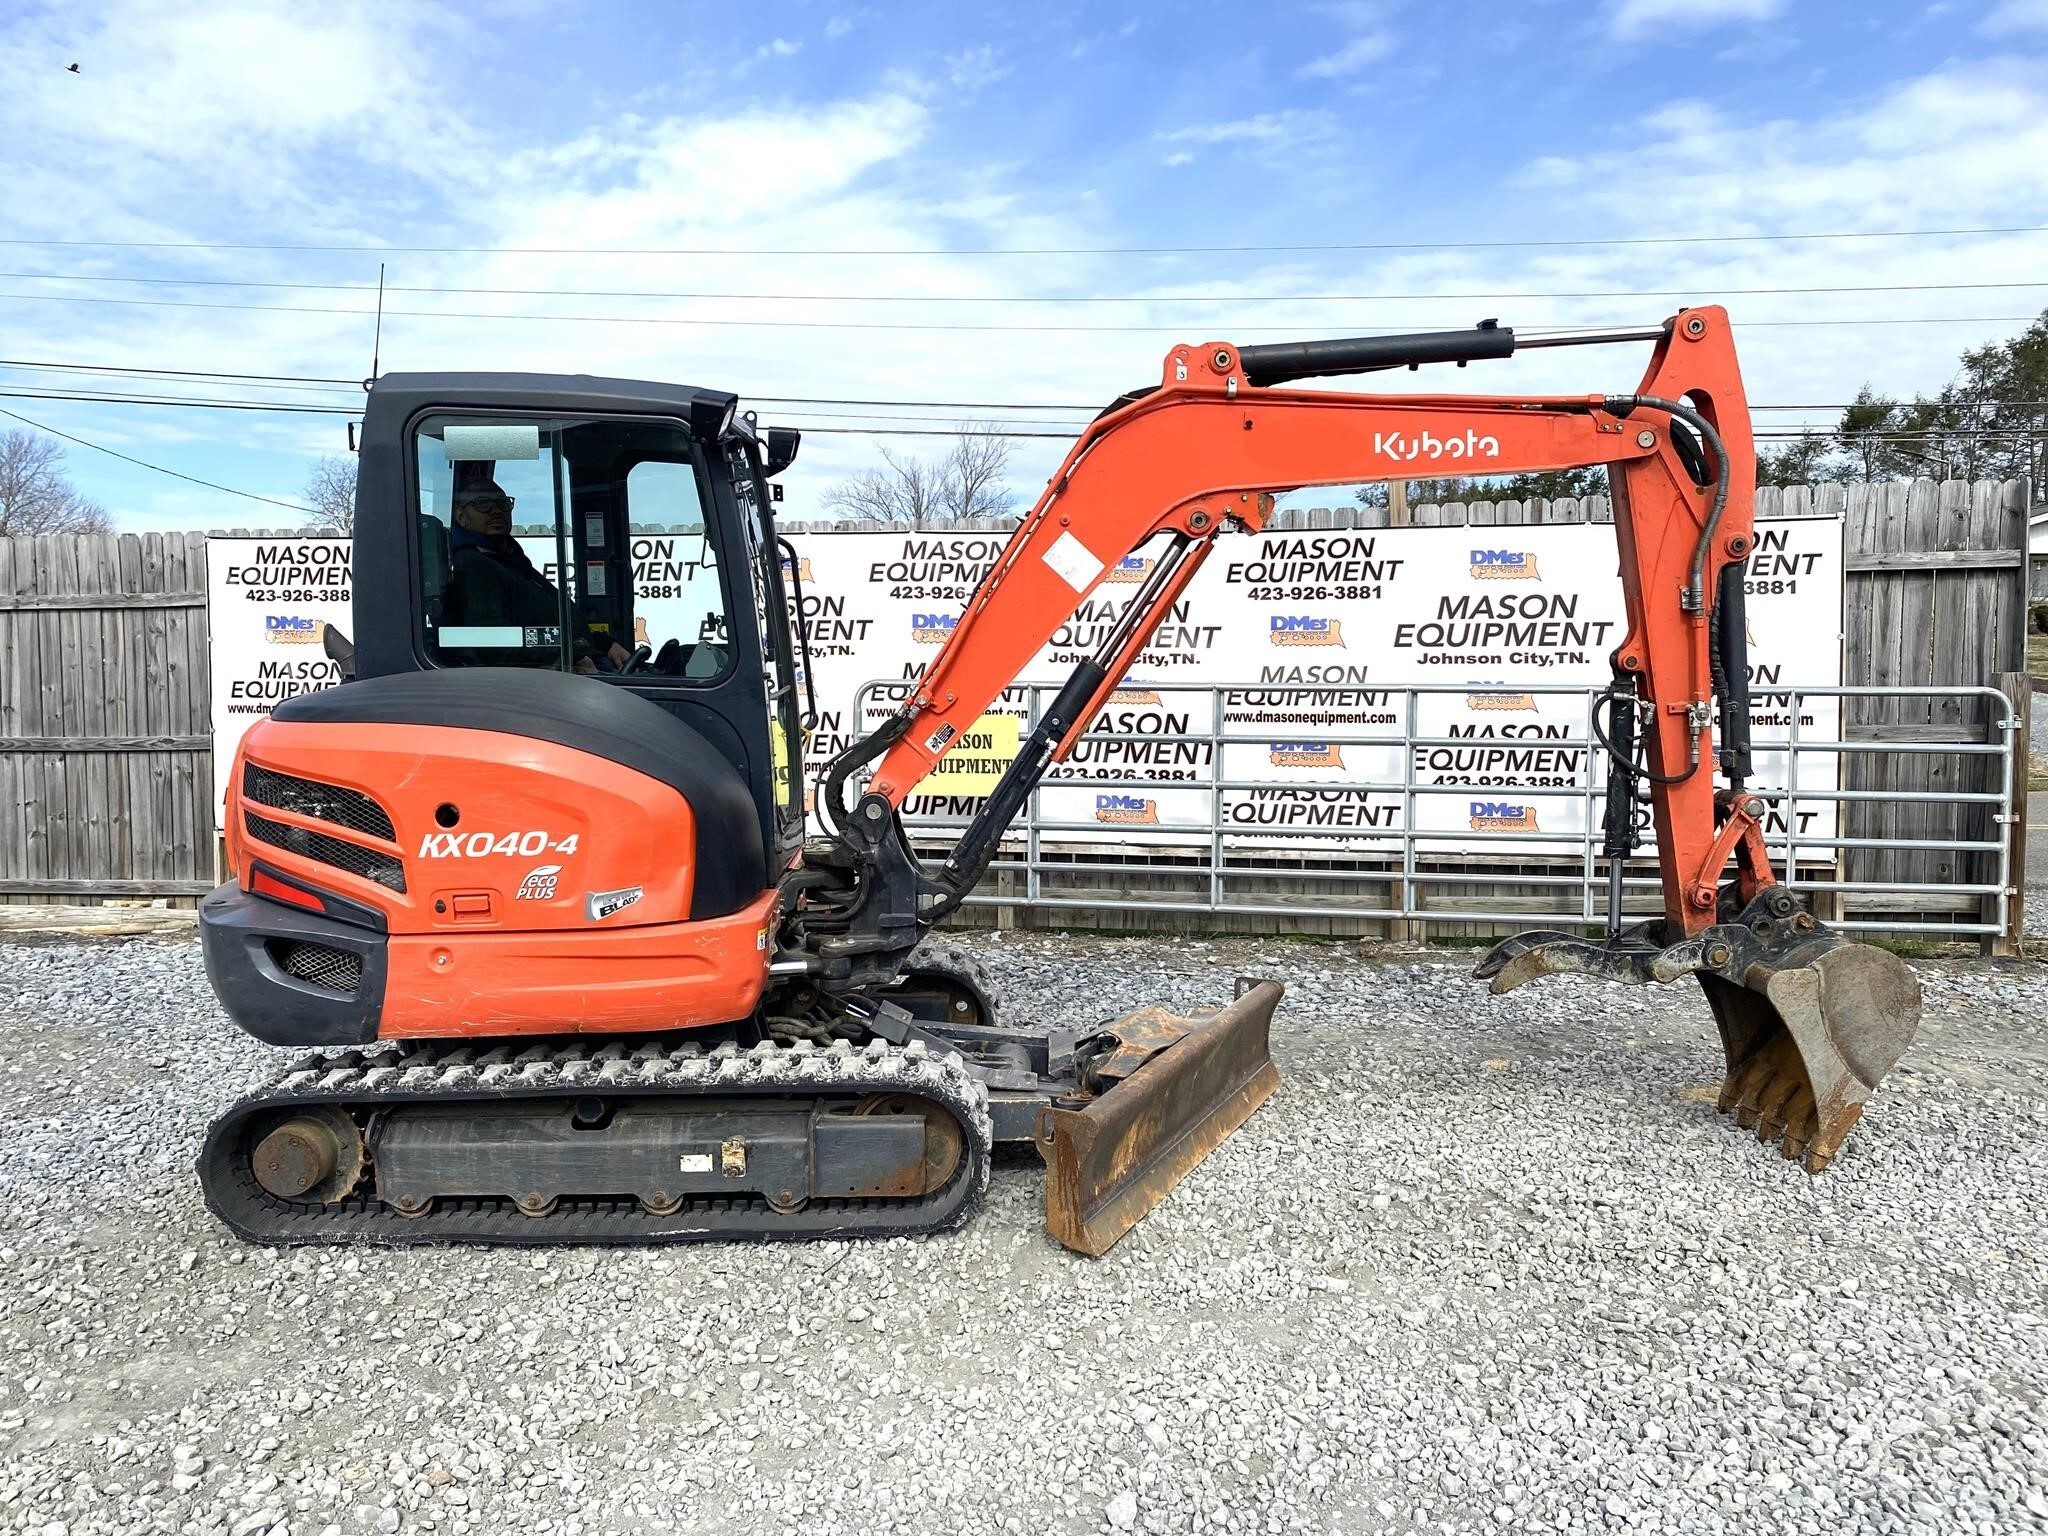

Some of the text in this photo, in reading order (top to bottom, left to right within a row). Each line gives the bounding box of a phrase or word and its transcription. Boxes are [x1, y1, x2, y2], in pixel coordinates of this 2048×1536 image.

[1374, 428, 1499, 461] Kubota
[256, 545, 351, 565] MASON
[1261, 537, 1375, 560] MASON
[226, 566, 353, 586] EQUIPMEN
[869, 562, 992, 583] EQUIPM
[1226, 560, 1404, 583] EQUIPMENT
[246, 589, 351, 602] 423-926-388
[890, 586, 979, 600] 423-926-
[1248, 585, 1382, 601] 423-926-3881
[1437, 594, 1578, 620] MASON
[1393, 622, 1613, 648] EQUIPMENT
[1417, 652, 1502, 665] Johnson
[1260, 665, 1368, 684] MASON
[231, 681, 337, 699] EQUIPM
[1227, 690, 1389, 707] EQUIPMENT
[1086, 712, 1189, 735] ASON
[1224, 710, 1396, 727] www.dmasonequipment.com
[952, 734, 992, 750] ASON
[1065, 741, 1213, 766] UIPMENT
[929, 758, 1013, 777] UIPMENT
[1223, 802, 1401, 827] EQUIPMENT
[418, 831, 580, 859] KX040-4
[527, 875, 558, 888] eco
[515, 887, 556, 900] PLUS
